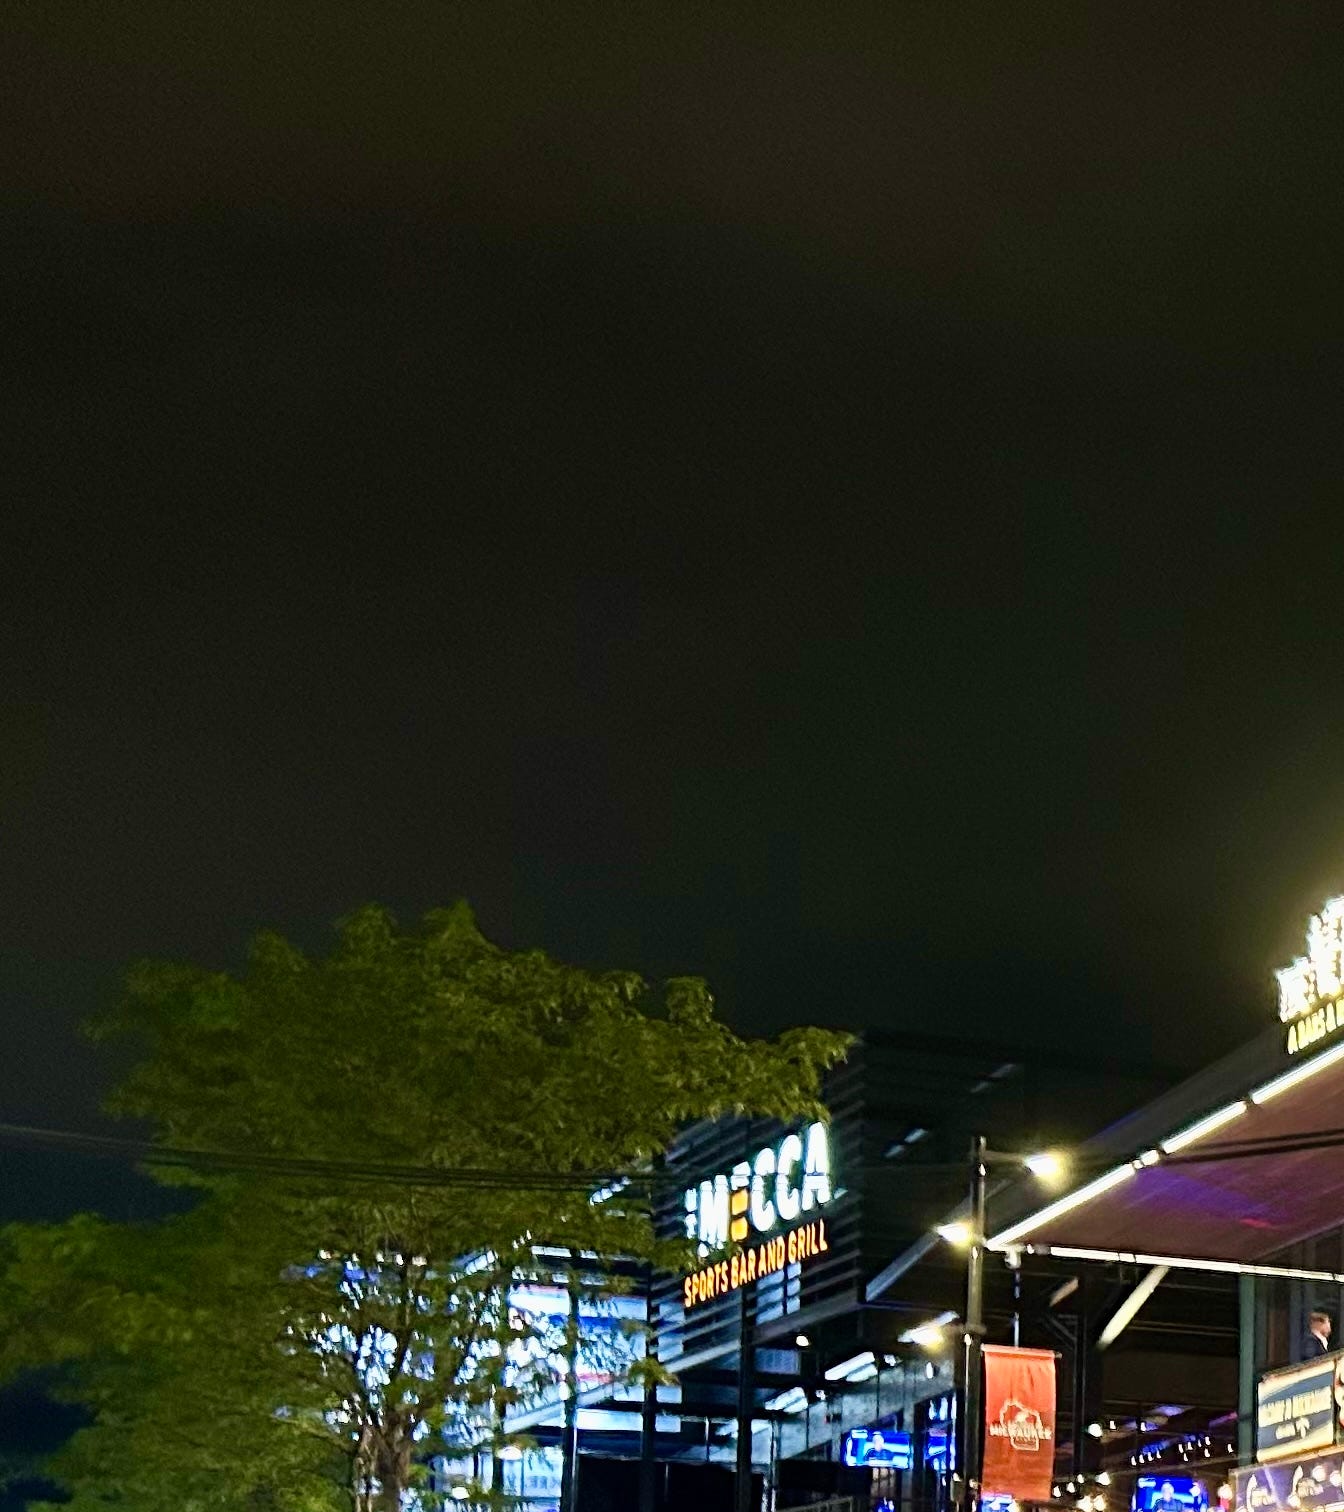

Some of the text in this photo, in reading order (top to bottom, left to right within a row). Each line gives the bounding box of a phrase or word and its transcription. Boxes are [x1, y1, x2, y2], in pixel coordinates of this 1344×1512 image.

[684, 1217, 829, 1308] SPORTS BAR AND GRILL
